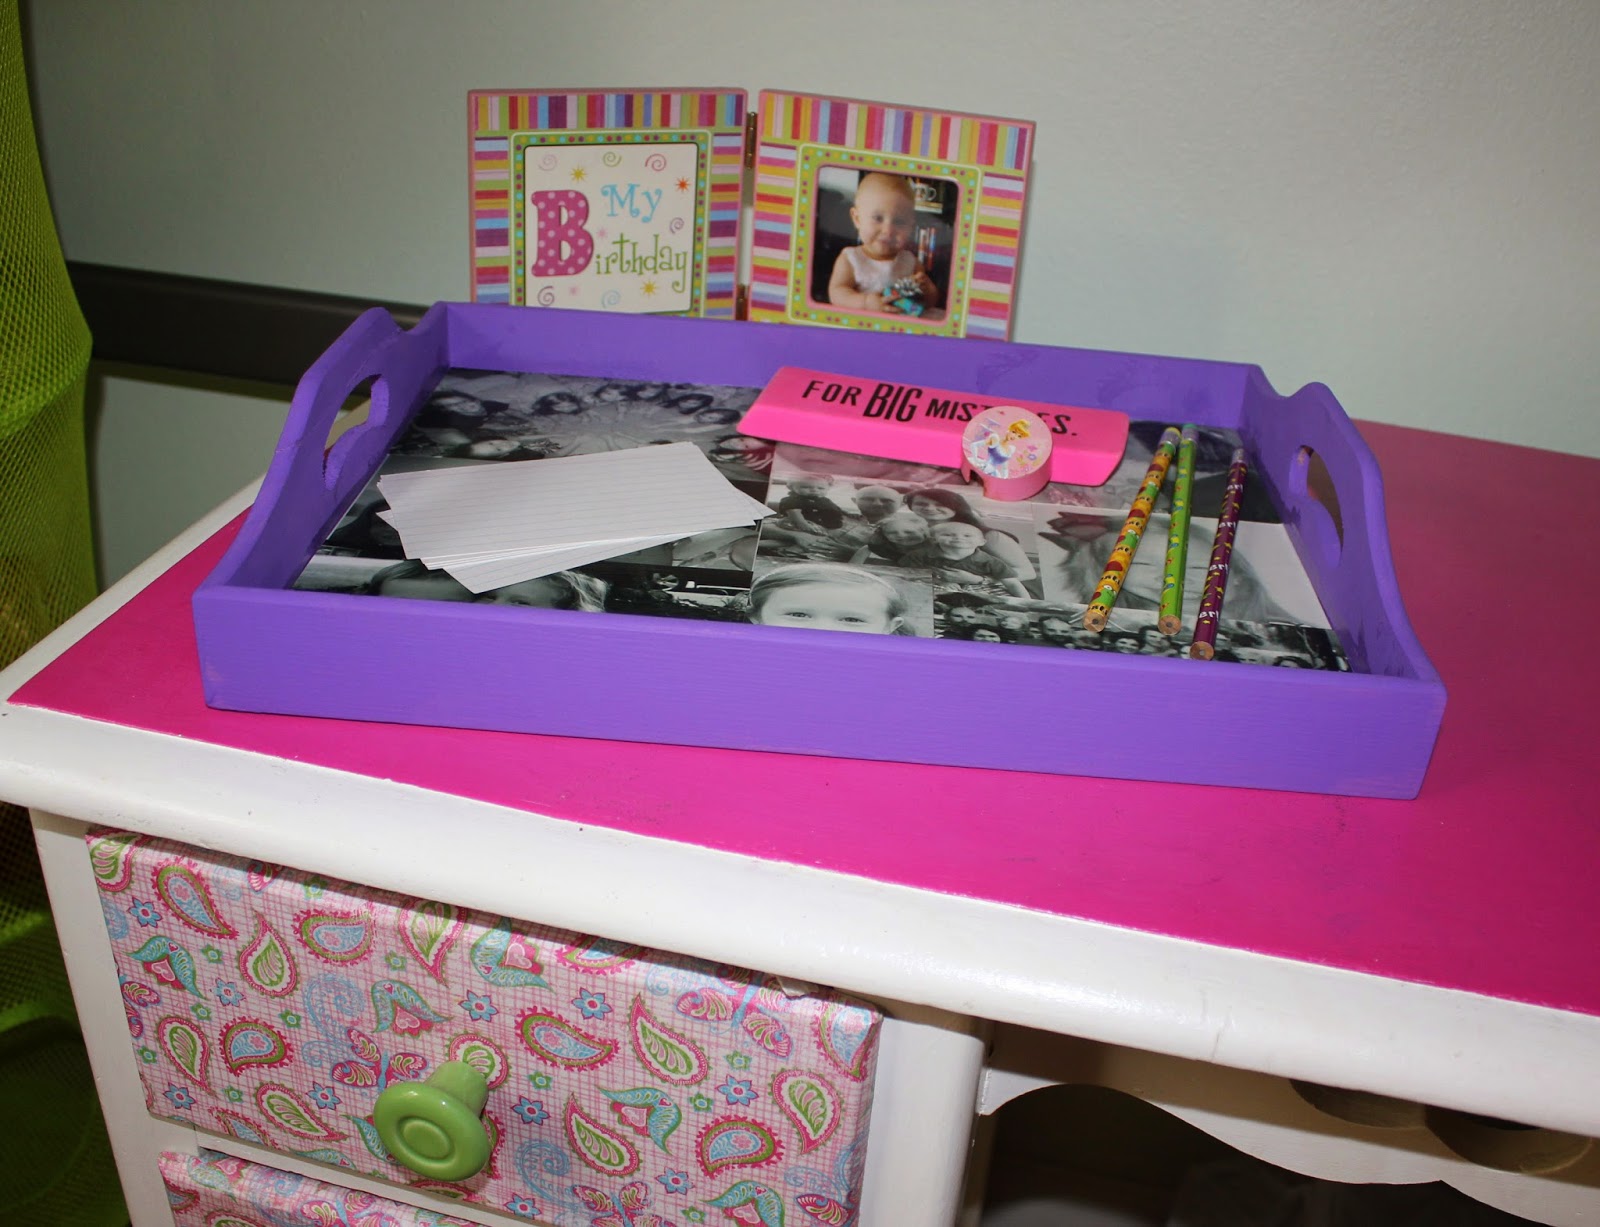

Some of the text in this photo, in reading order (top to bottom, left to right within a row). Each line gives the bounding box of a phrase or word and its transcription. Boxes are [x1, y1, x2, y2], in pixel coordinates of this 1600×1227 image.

[600, 183, 663, 223] My
[531, 189, 688, 294] Birthday
[802, 380, 1078, 436] FOR BIG MISS.
